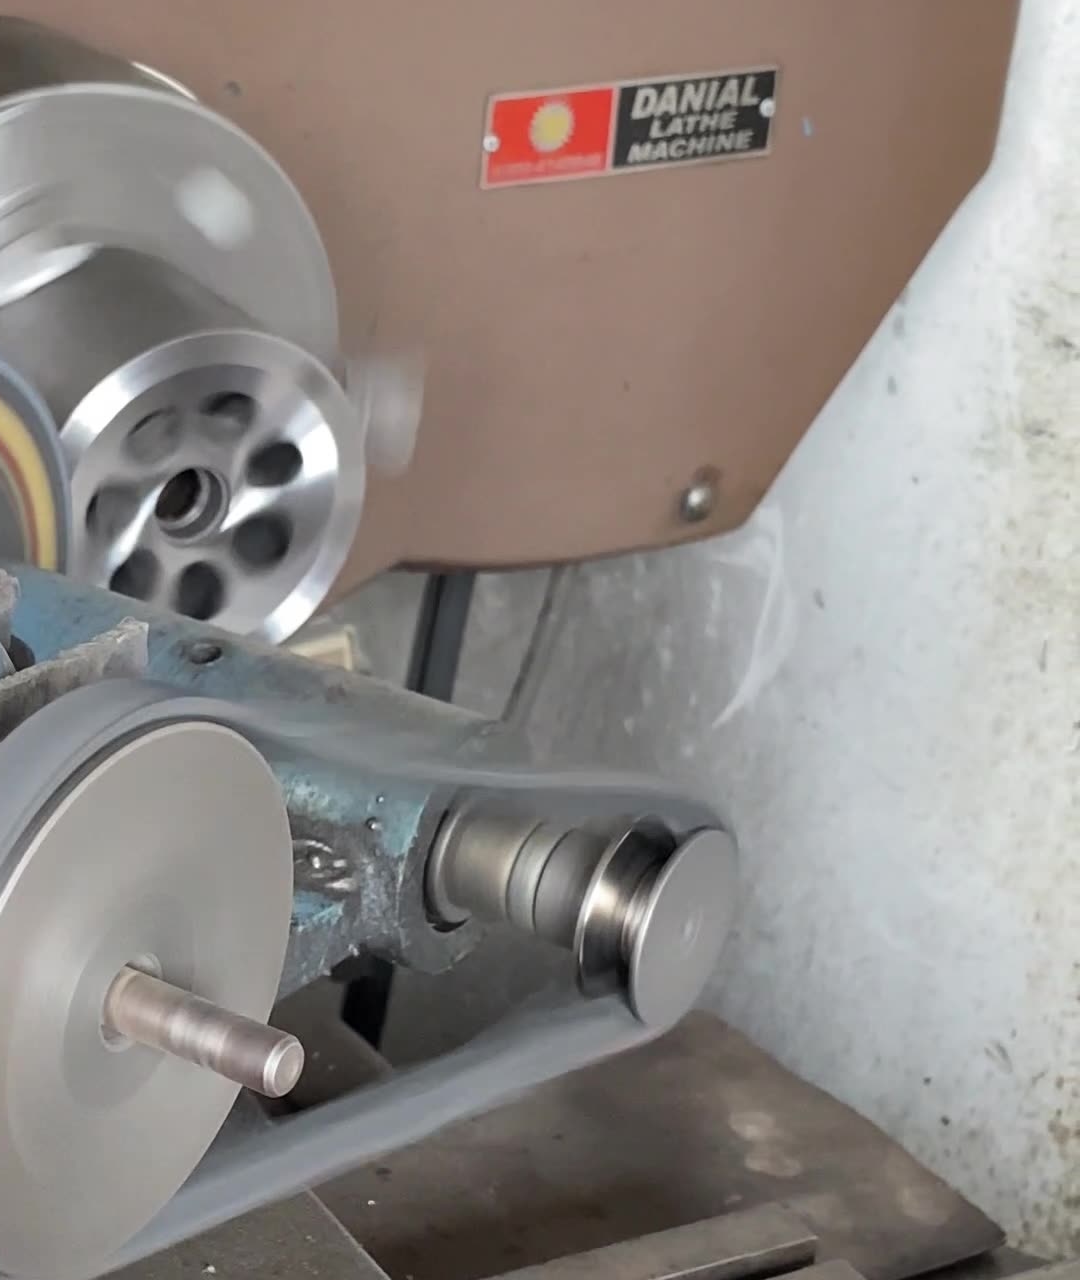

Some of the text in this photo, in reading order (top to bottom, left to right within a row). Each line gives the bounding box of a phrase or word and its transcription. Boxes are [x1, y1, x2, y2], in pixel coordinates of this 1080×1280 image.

[631, 75, 760, 119] DANIAL
[649, 107, 738, 138] LATHE
[627, 128, 754, 163] MACHINE
